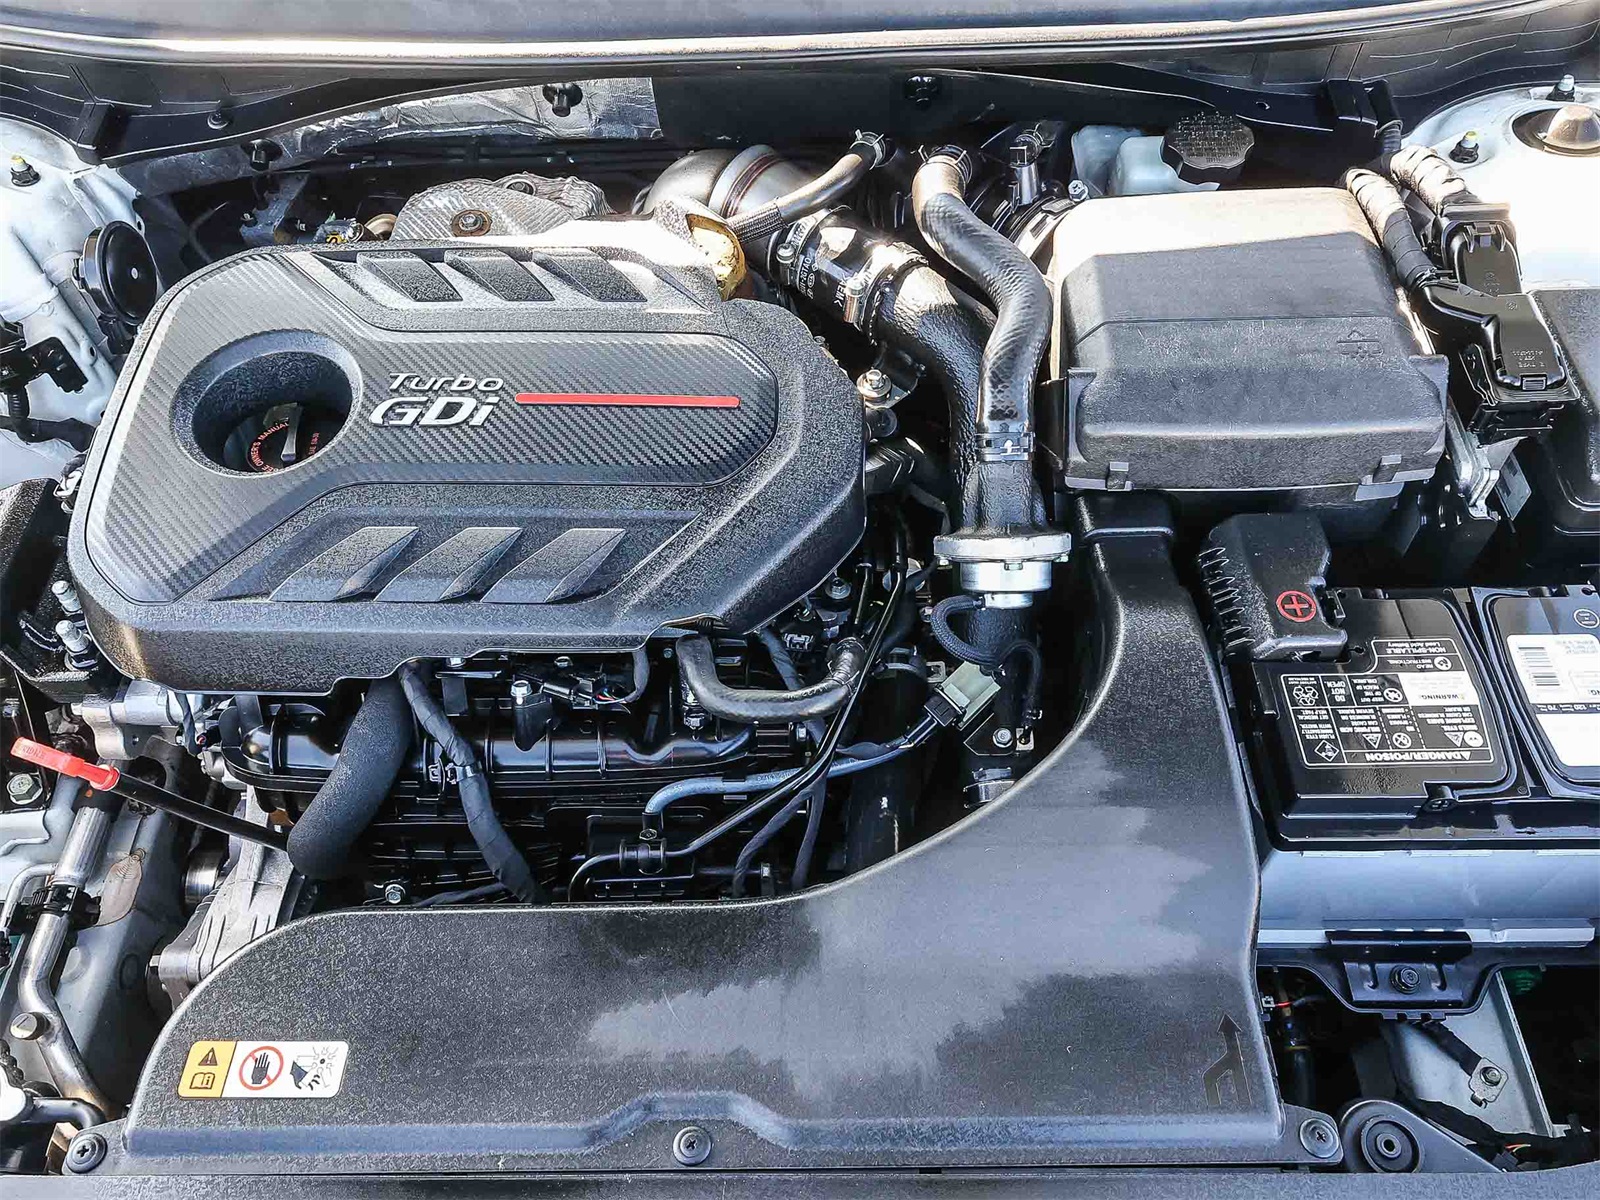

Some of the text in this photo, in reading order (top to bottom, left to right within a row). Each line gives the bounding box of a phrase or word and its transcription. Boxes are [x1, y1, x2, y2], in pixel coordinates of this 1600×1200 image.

[389, 372, 504, 391] Turbo
[369, 396, 500, 426] GDi
[1364, 752, 1460, 761] DANGER/POISON
